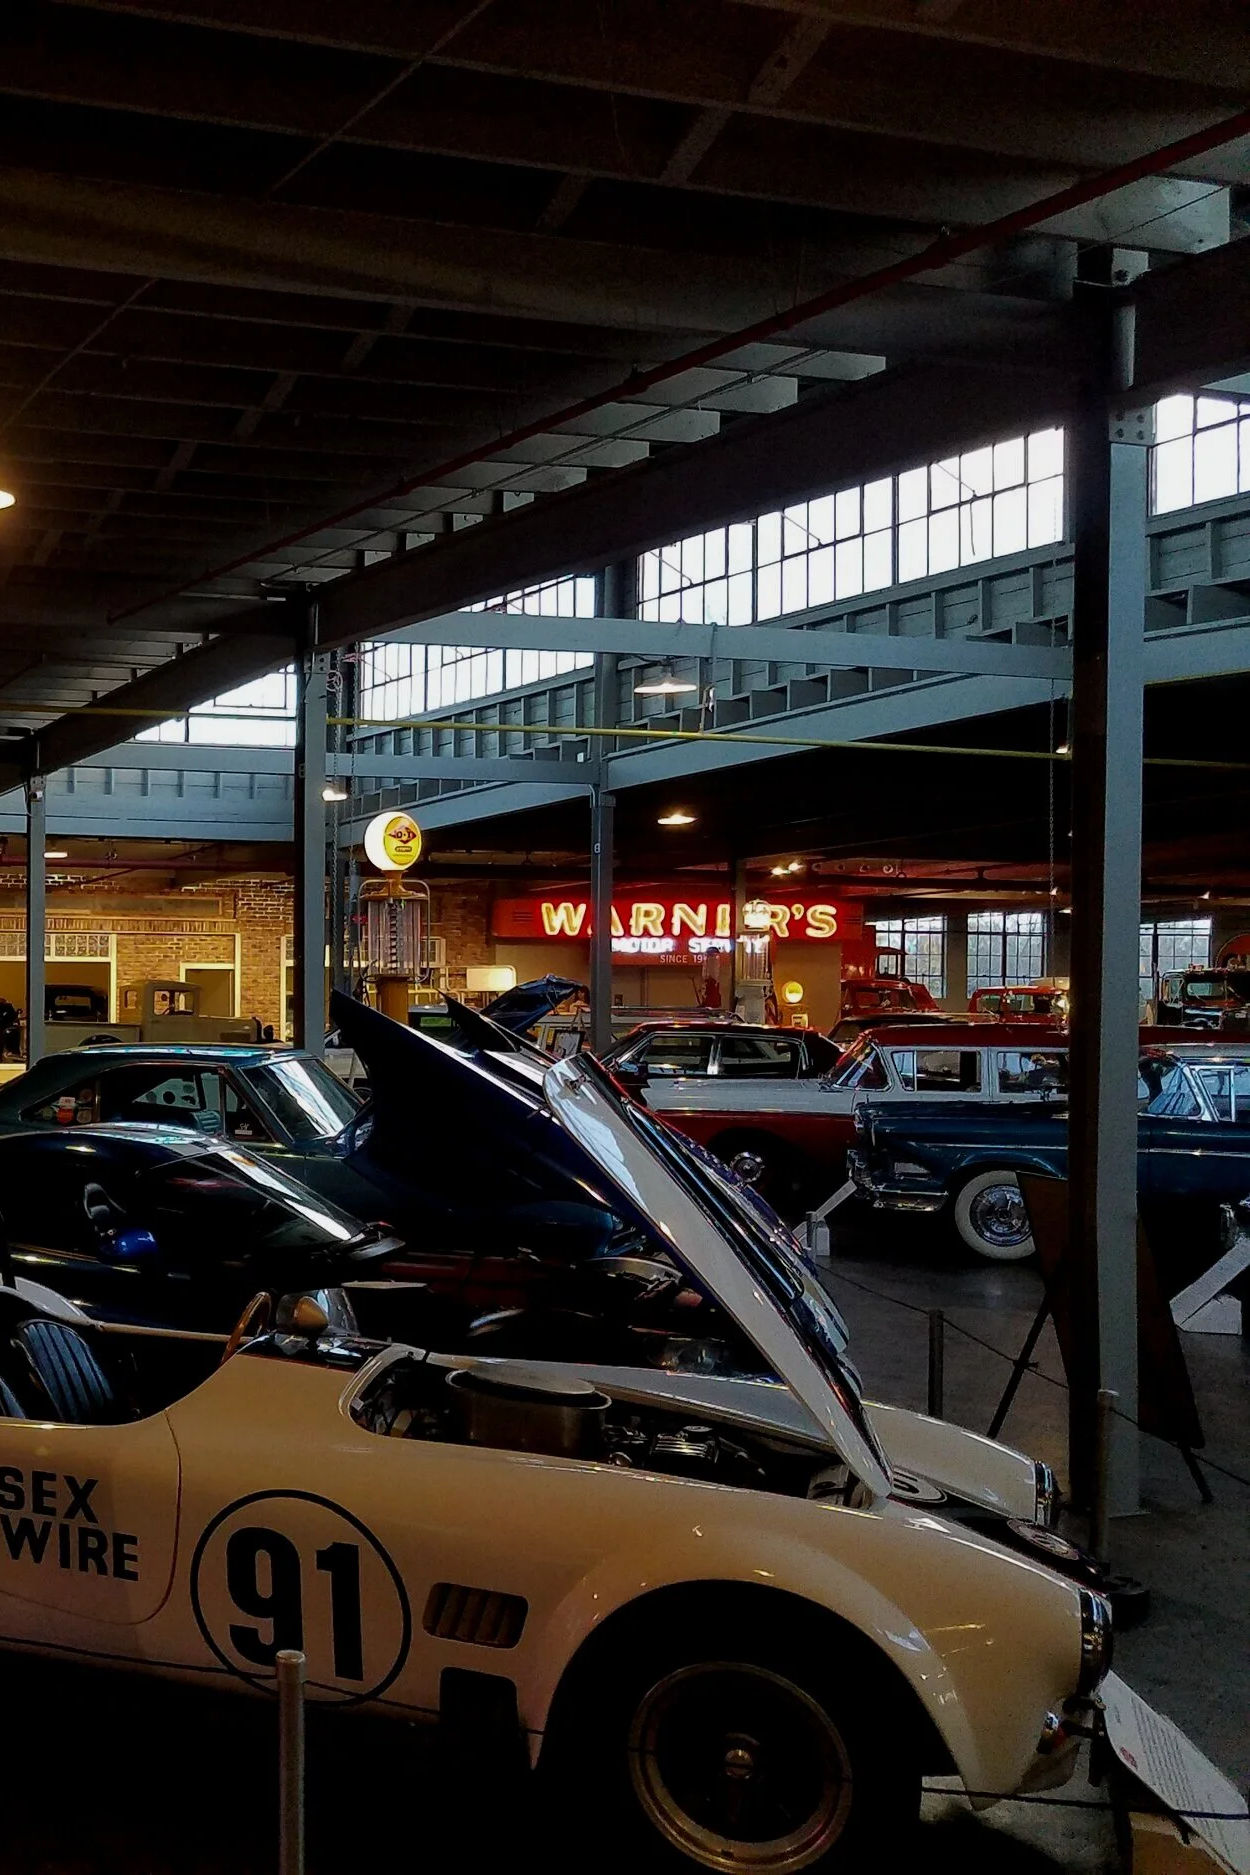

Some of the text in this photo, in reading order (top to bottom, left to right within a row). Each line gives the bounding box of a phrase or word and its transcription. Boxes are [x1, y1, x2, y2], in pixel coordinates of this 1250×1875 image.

[611, 937, 675, 954] MOTOR
[660, 954, 688, 964] SINCE
[0, 1513, 139, 1582] WIRE
[226, 1526, 365, 1682] 91
